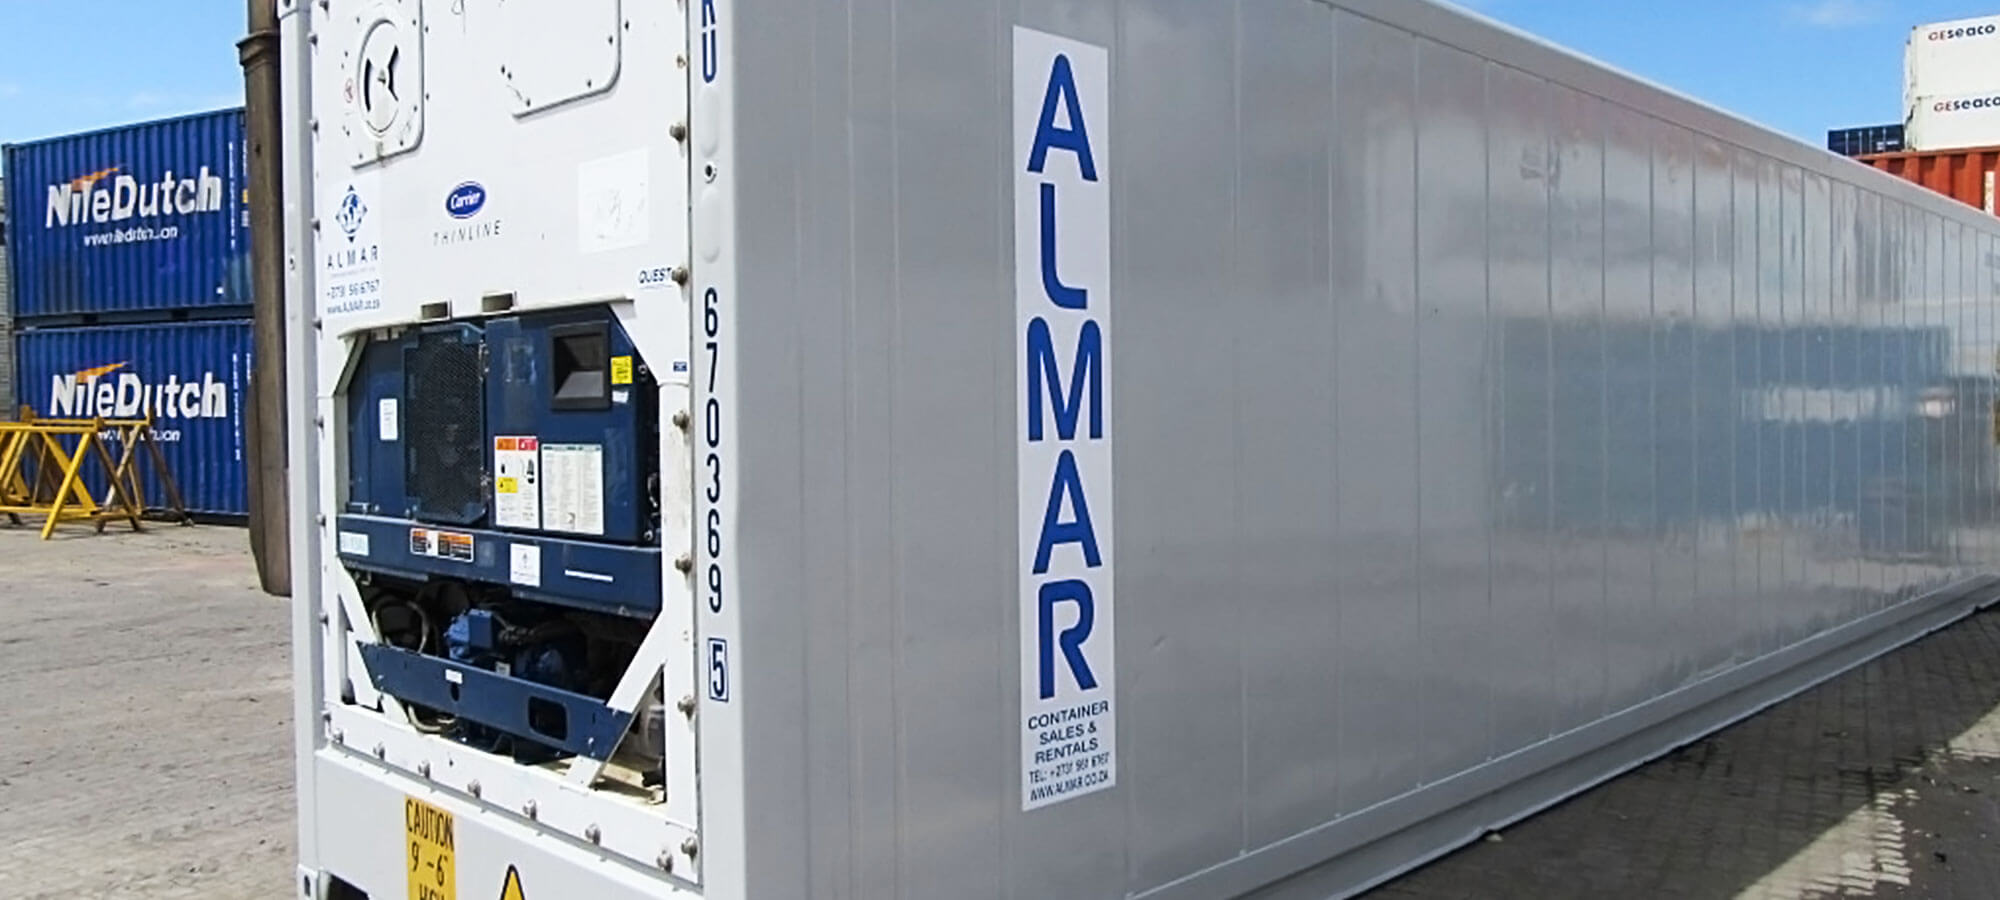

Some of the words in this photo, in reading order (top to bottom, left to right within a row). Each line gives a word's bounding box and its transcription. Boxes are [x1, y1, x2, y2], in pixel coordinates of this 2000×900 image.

[46, 166, 222, 228] NileDutch
[450, 190, 481, 209] Carrier
[433, 220, 501, 246] THINLINE
[327, 245, 378, 269] ALMAR
[638, 267, 672, 283] QUEST
[1027, 54, 1103, 699] ALMAR
[50, 372, 227, 418] NileDutch
[704, 287, 722, 614] 670369
[710, 641, 727, 700] 5
[1028, 700, 1109, 730] CONTAINER
[1039, 723, 1084, 745] SALES
[1088, 721, 1097, 734] &
[1035, 738, 1098, 764] RENTALS
[406, 799, 454, 852] CAUTION
